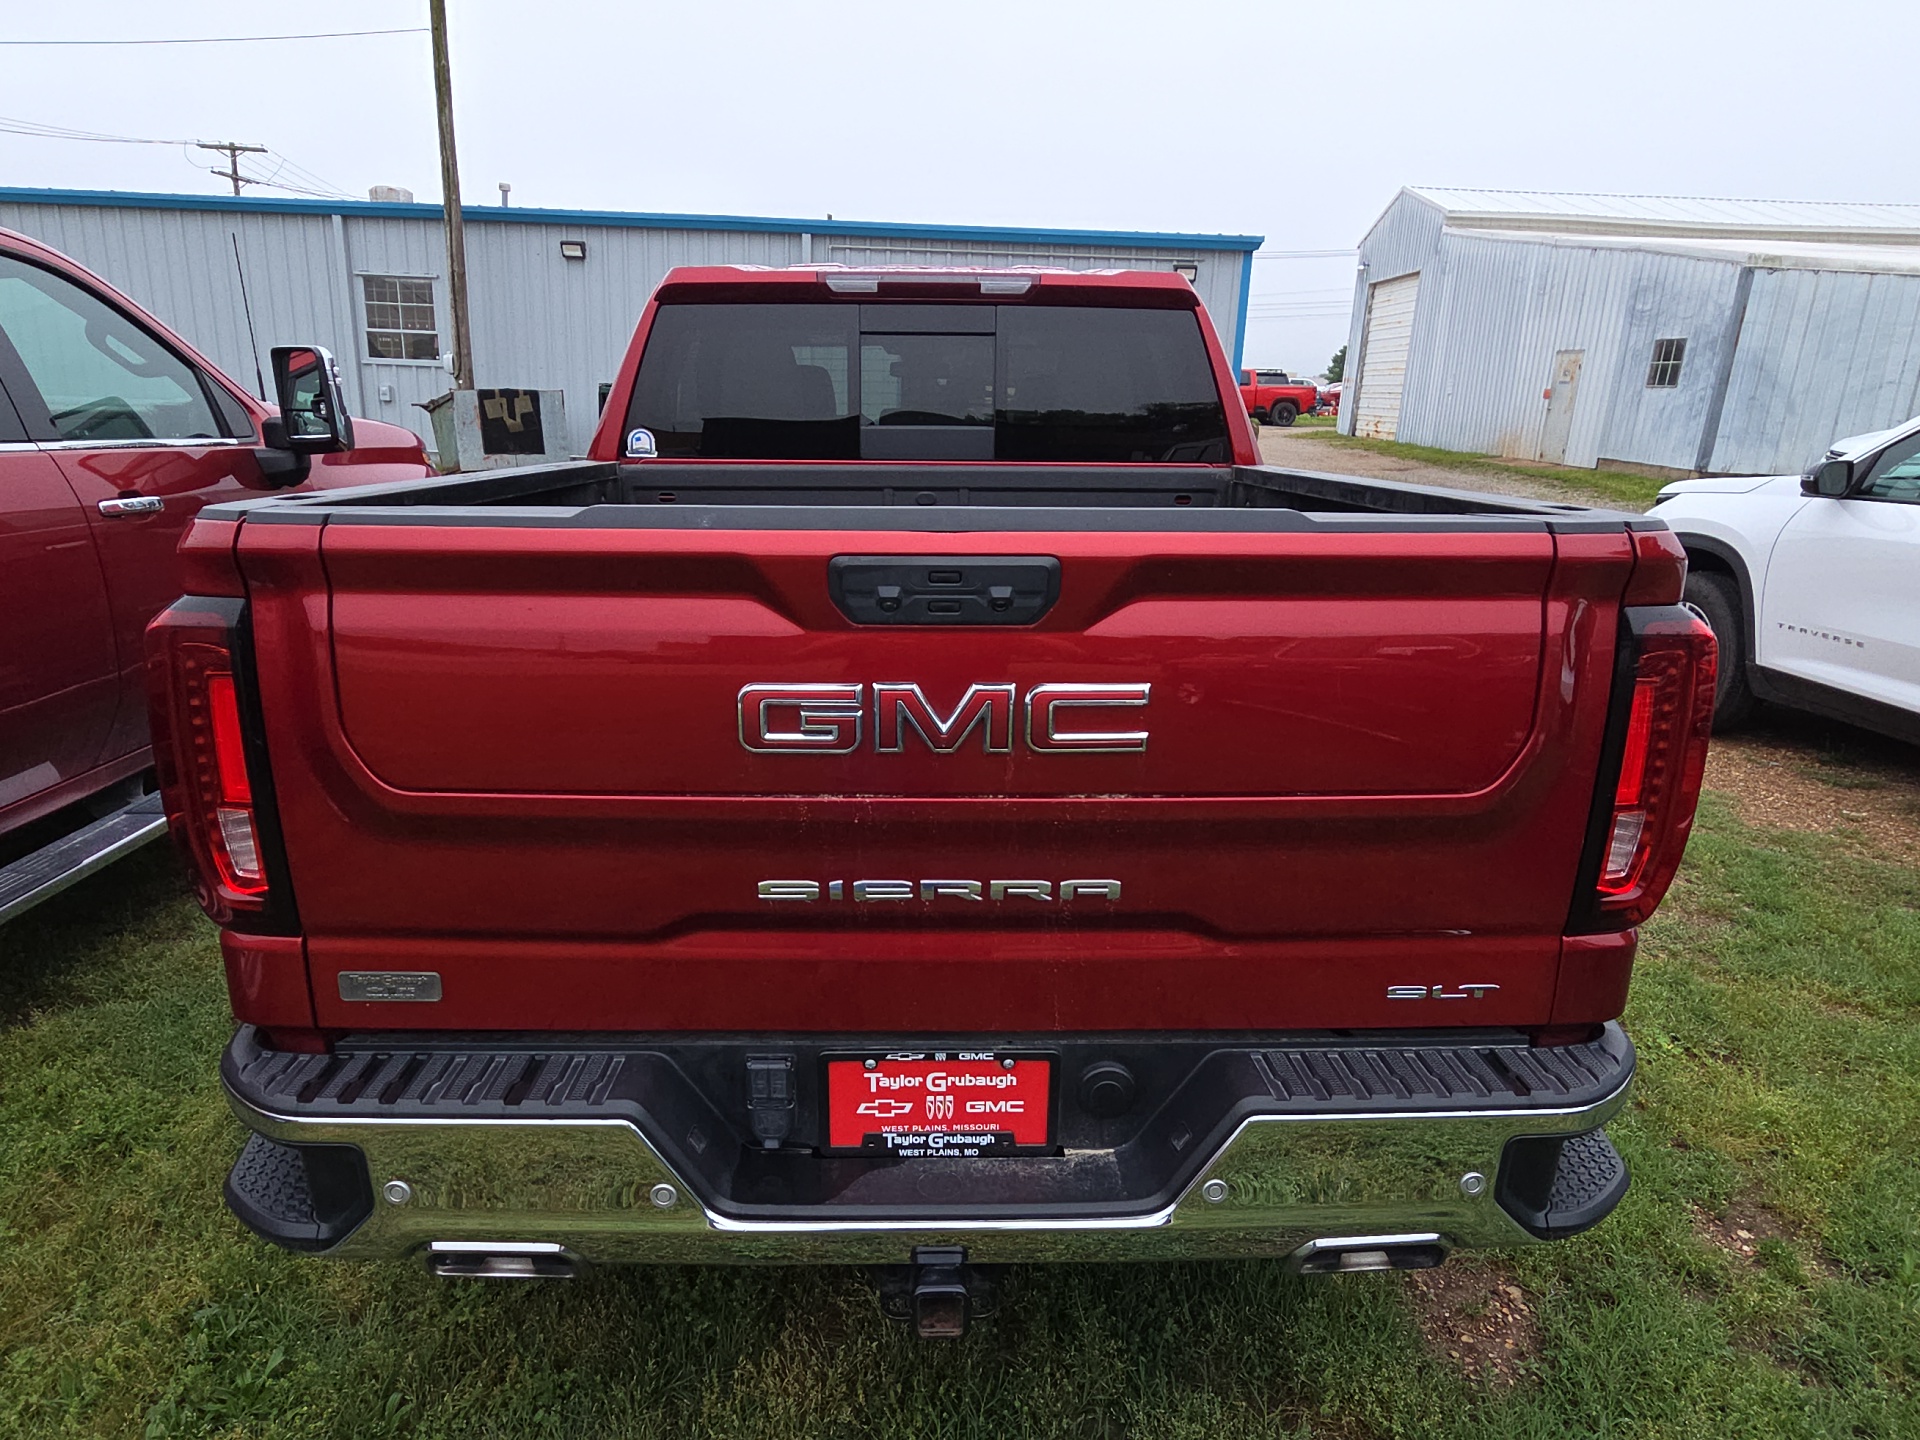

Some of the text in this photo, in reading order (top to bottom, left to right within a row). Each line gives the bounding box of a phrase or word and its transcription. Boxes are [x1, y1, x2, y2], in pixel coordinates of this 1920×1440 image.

[1777, 622, 1865, 648] TRAVERSE
[737, 682, 1152, 754] GMC
[757, 879, 1122, 901] SIERRA
[1386, 983, 1500, 999] SLT
[958, 1052, 994, 1060] GMC
[863, 1072, 1017, 1092] Taylor Grubaugh
[965, 1100, 1025, 1113] GMC
[912, 1124, 950, 1132] PLAINS,
[952, 1123, 1000, 1132] MISSOURI
[882, 1133, 995, 1148] Taylor Grubaugh
[898, 1148, 979, 1157] WEST PLAINS, MO
